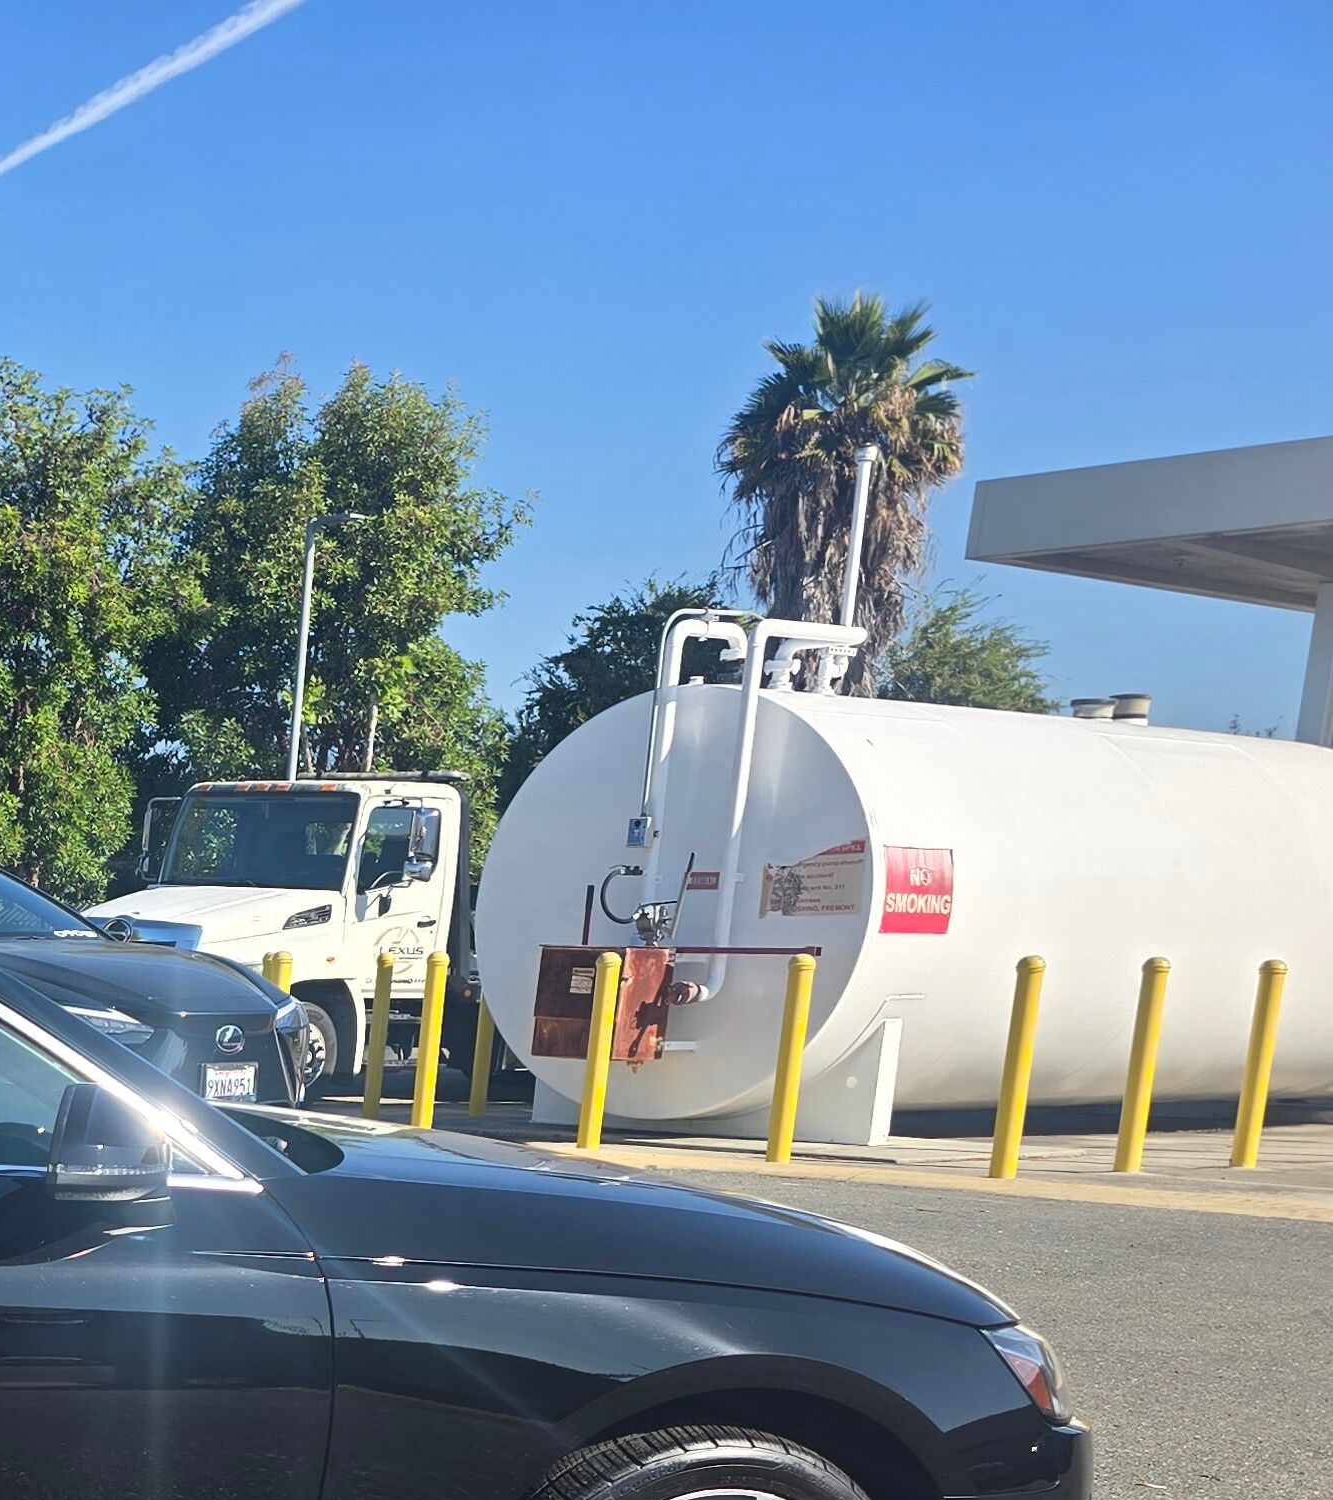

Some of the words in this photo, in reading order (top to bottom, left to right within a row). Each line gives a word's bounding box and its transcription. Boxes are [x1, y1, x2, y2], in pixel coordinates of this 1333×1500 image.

[909, 867, 932, 886] NO
[885, 892, 951, 915] SMOKING
[207, 1078, 251, 1097] 9XNA951
